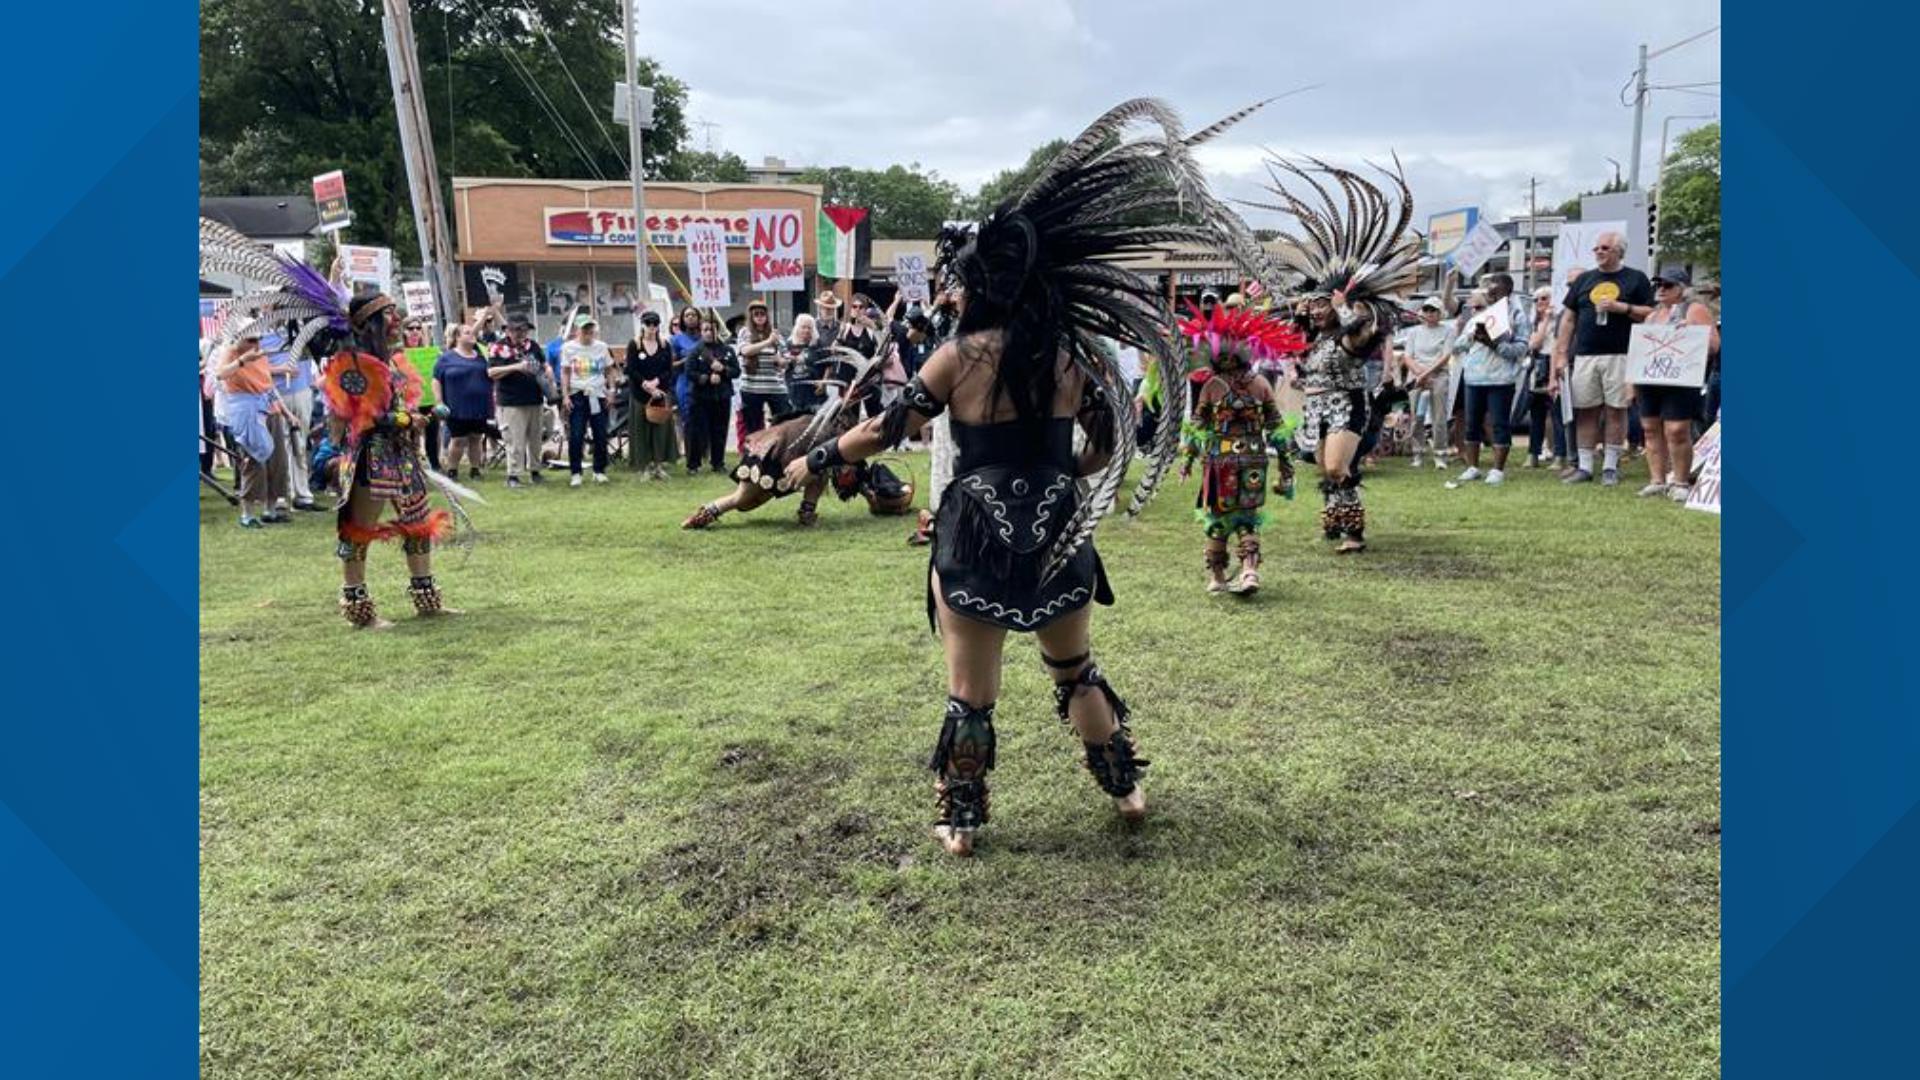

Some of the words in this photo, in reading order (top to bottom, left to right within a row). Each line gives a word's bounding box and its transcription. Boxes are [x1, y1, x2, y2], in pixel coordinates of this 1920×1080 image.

[609, 233, 674, 244] COMETE
[753, 213, 800, 252] NO
[899, 256, 921, 270] NO
